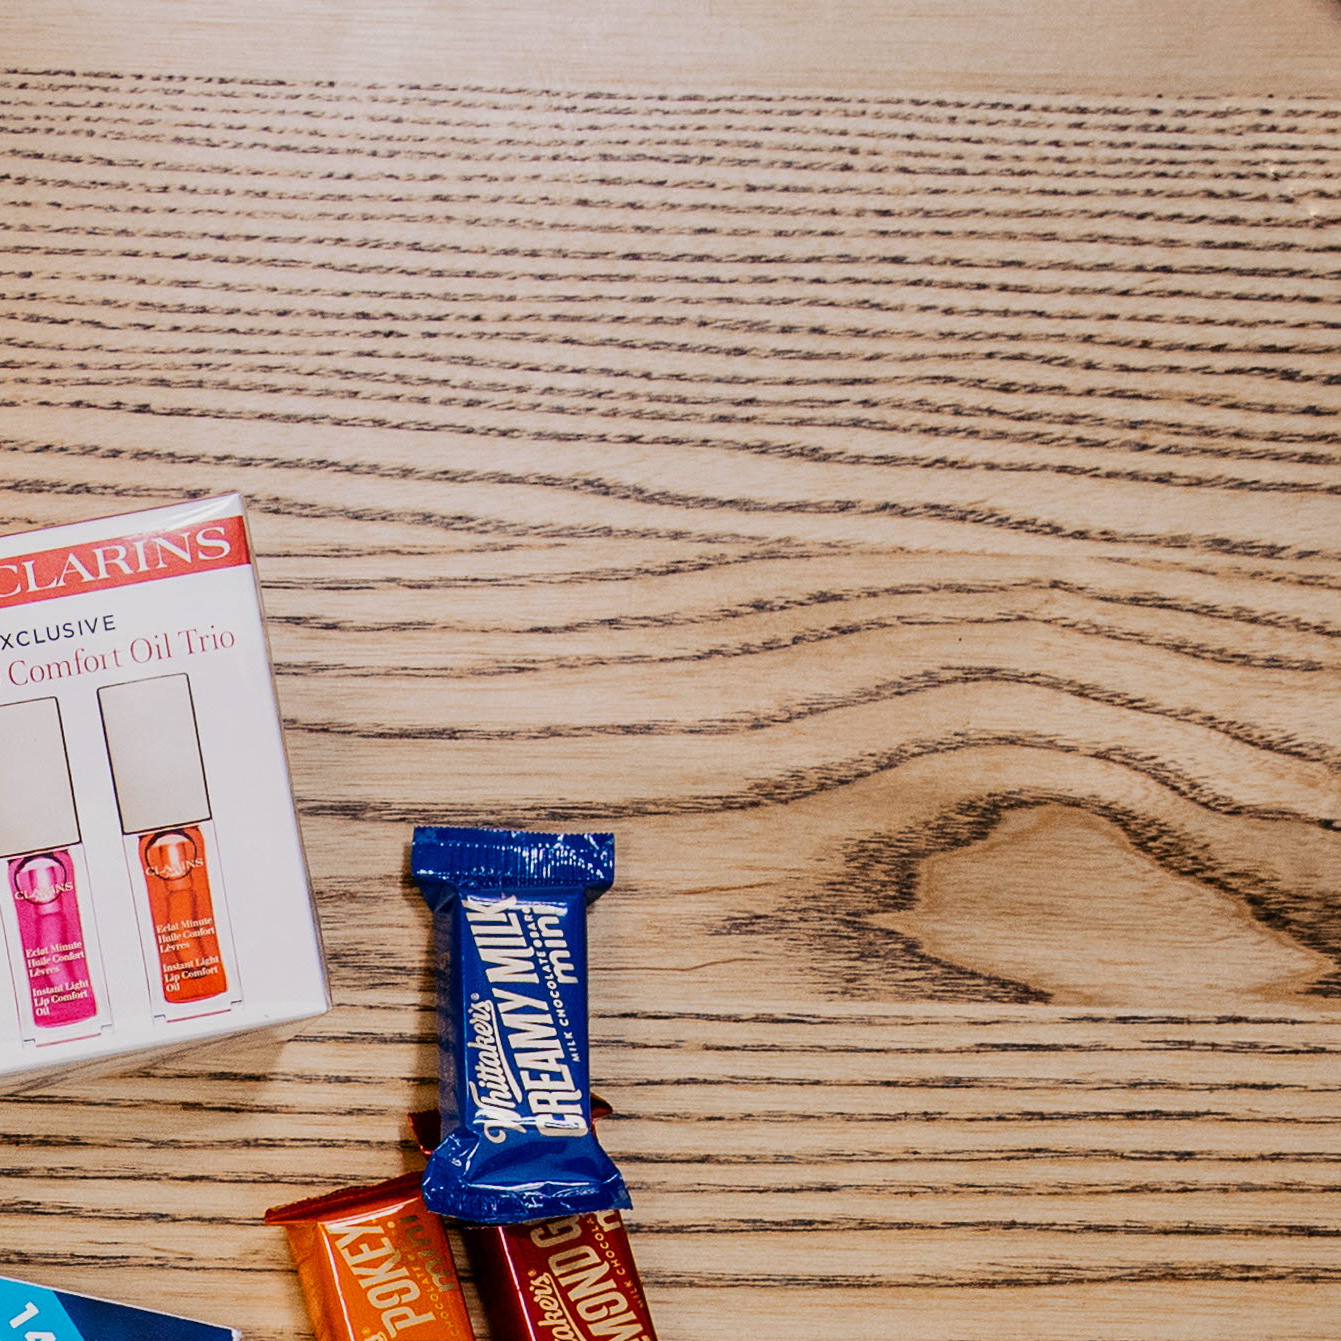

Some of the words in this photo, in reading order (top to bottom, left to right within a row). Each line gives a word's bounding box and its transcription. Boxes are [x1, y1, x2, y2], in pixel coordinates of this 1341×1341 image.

[8, 646, 123, 686] Comfort
[129, 632, 173, 663] Oil
[178, 625, 236, 655] Trio
[462, 896, 539, 983] MILK
[532, 907, 578, 983] mini
[535, 950, 569, 1027] CHOCOLATE
[467, 999, 527, 1144] Whittaker's
[492, 987, 588, 1137] CREAMY
[567, 1032, 581, 1062] MILK
[325, 1220, 436, 1339] POKEY
